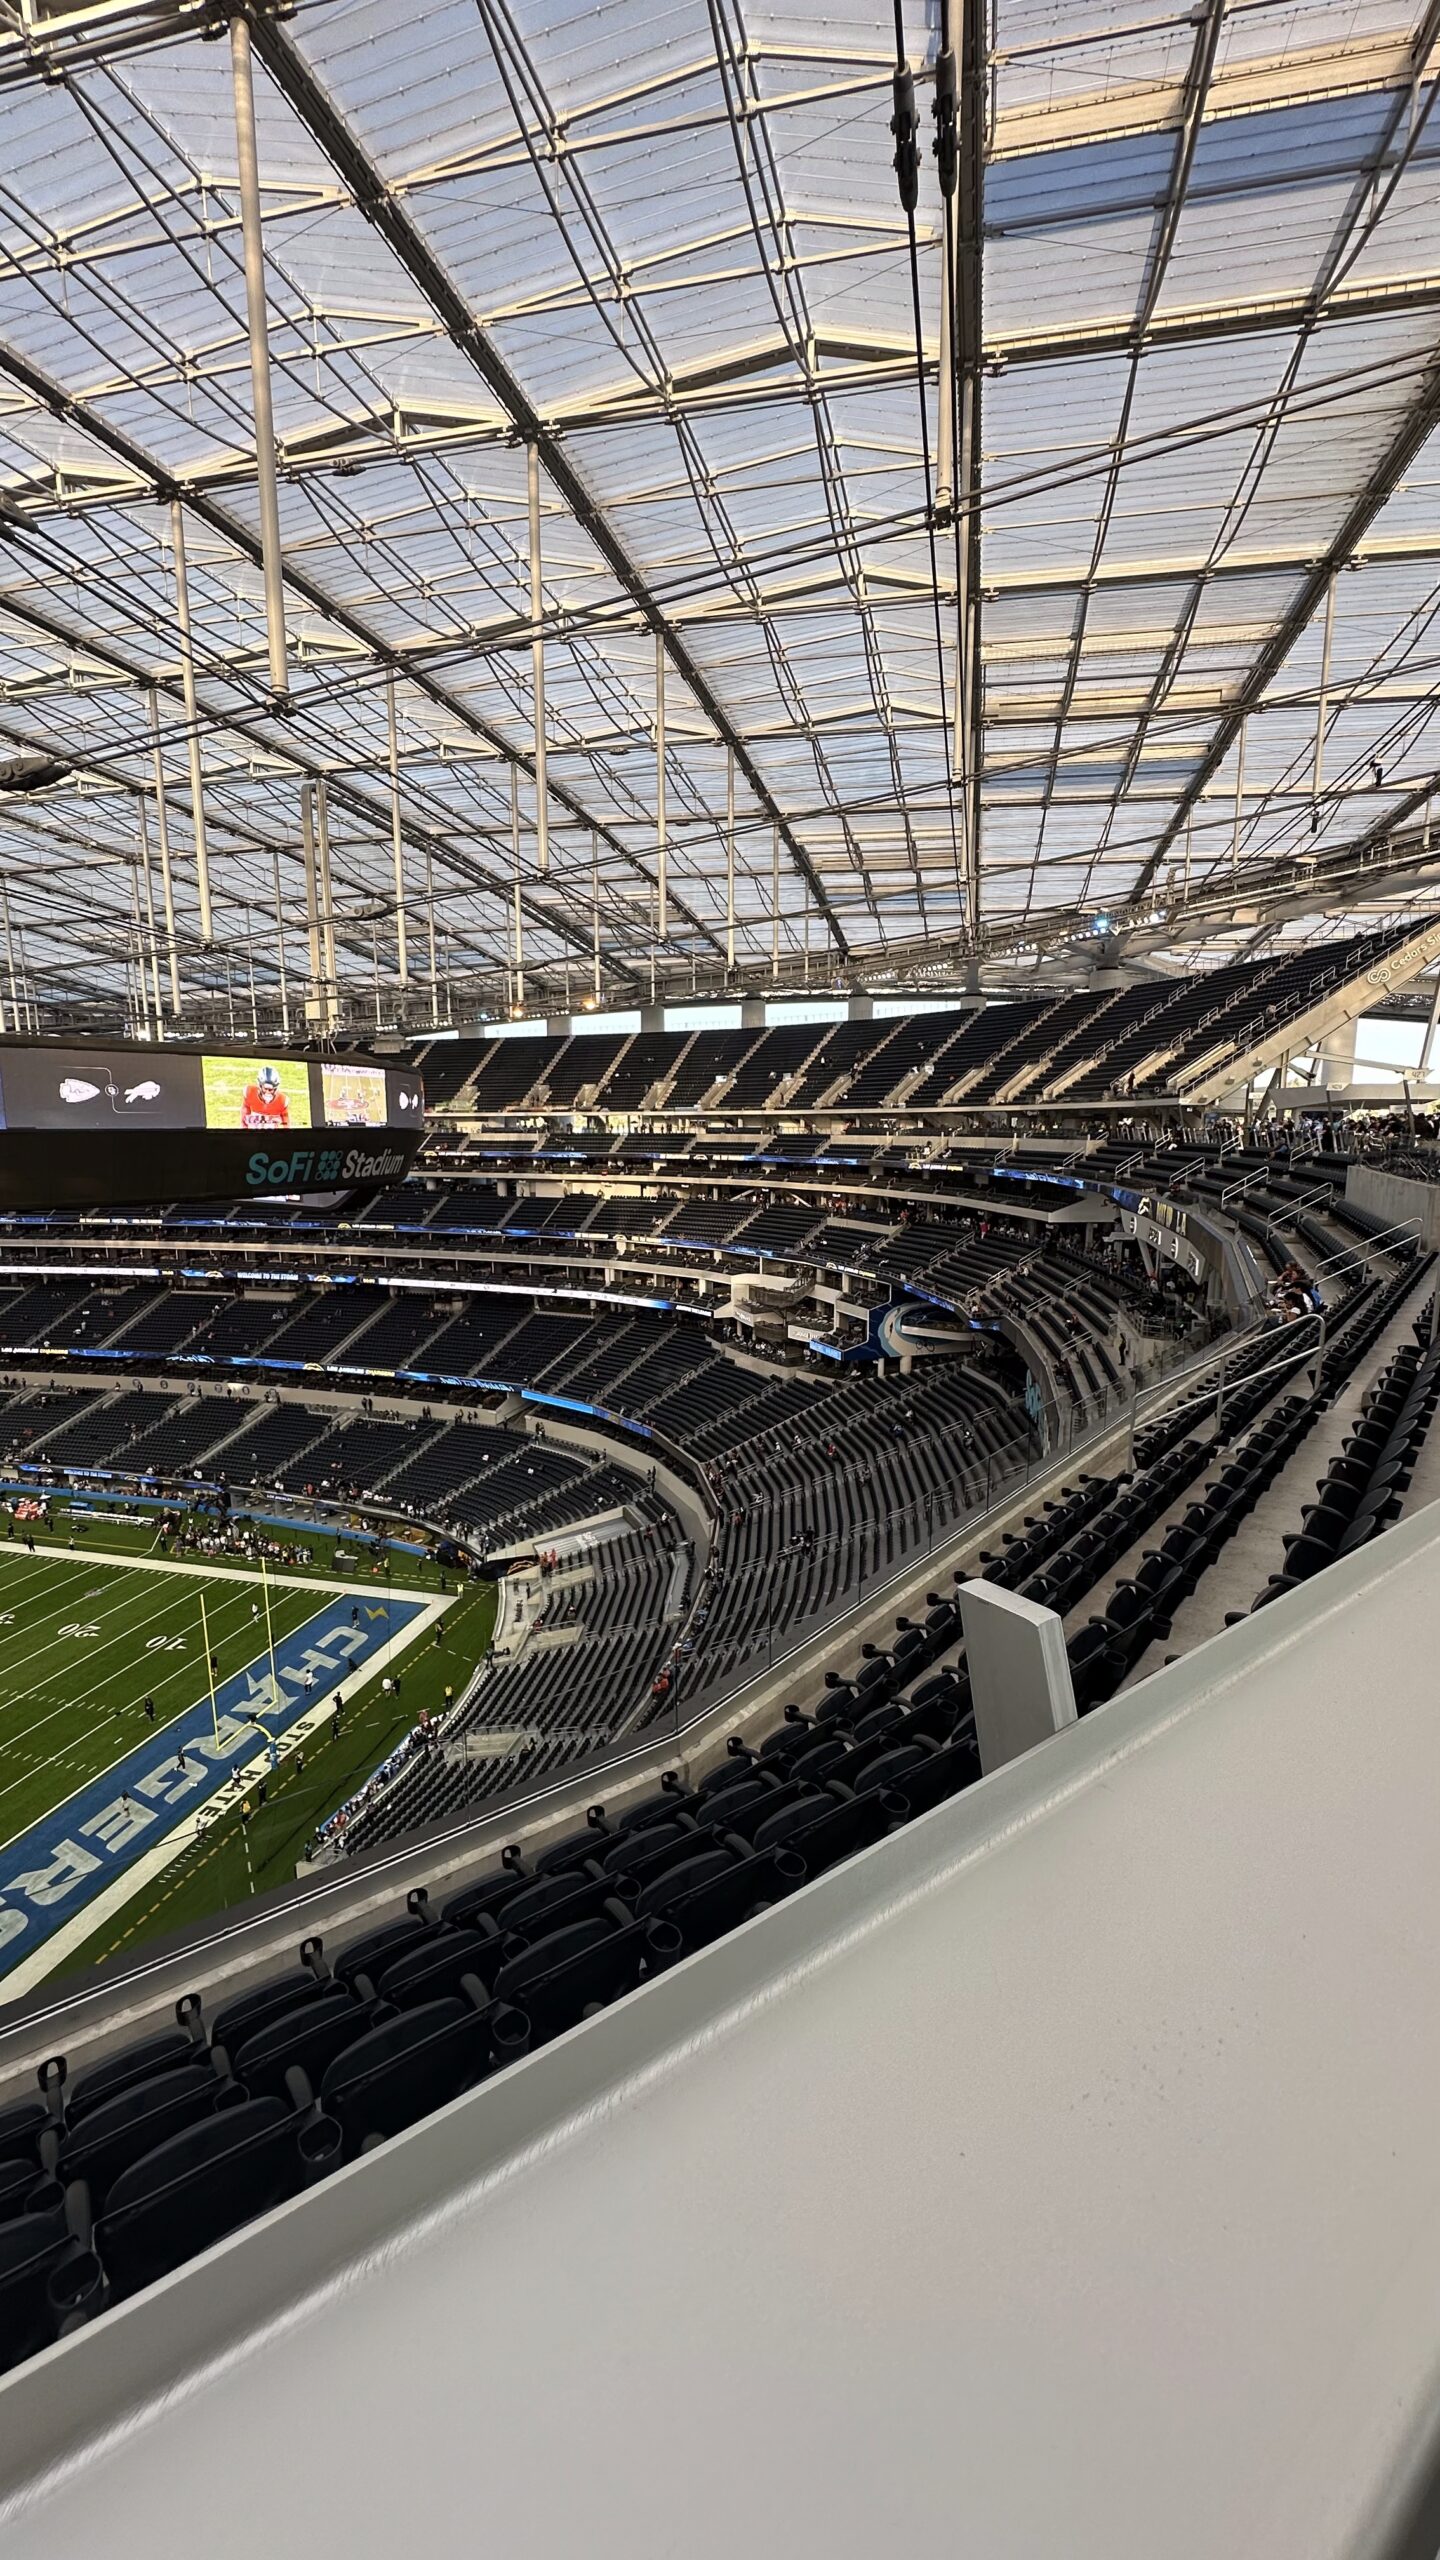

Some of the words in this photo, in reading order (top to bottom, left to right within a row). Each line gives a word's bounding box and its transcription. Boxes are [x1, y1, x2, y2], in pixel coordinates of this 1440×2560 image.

[1390, 944, 1428, 970] Cedars
[246, 1152, 315, 1185] SoFi
[342, 1148, 404, 1179] Stadium
[57, 1623, 101, 1638] 20
[145, 1635, 188, 1651] 10
